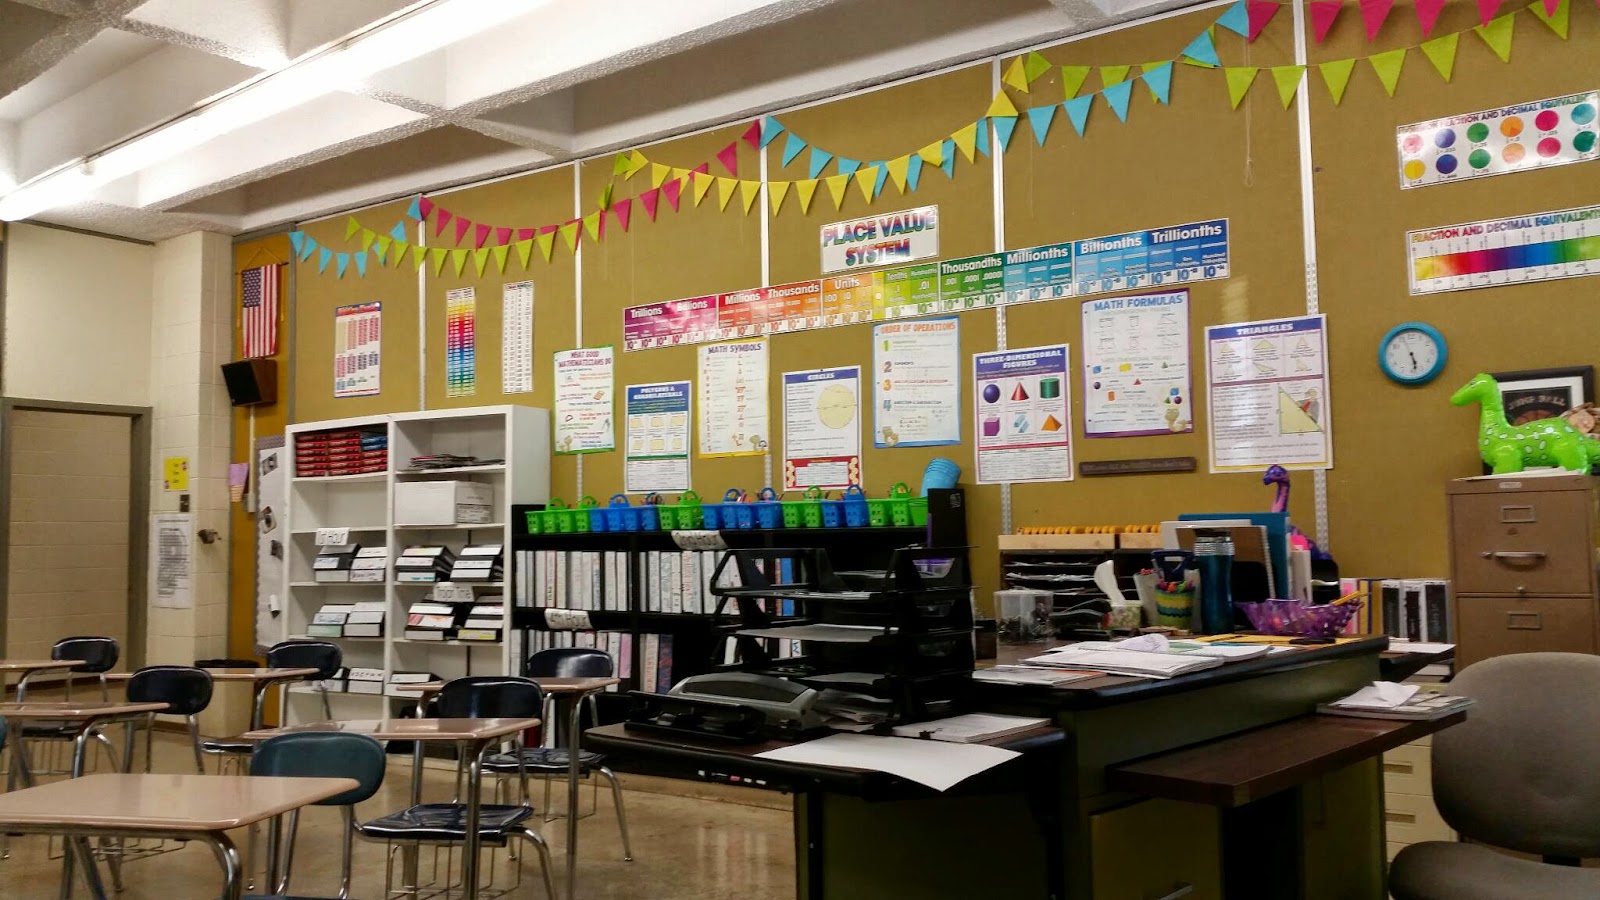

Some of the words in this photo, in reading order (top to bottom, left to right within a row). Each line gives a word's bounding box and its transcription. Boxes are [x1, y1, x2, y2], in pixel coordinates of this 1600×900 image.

[1481, 111, 1499, 121] AND
[1500, 105, 1538, 117] DECIMAL
[823, 219, 878, 248] PLACE
[880, 210, 937, 238] VALUE
[1413, 230, 1460, 244] FRACTION
[1463, 226, 1484, 237] AND
[1487, 219, 1533, 234] DECIMAL
[1536, 208, 1600, 226] EQUIVALENT
[1081, 235, 1143, 255] Billionths
[1152, 224, 1223, 244] Trillionths
[846, 238, 911, 267] SYSTEM
[942, 256, 1003, 274] Thousandths
[1007, 246, 1068, 265] Millionths
[834, 277, 860, 290] Units
[725, 292, 761, 306] Millions
[768, 283, 820, 299] Thousands
[630, 307, 664, 319] Trillions
[677, 300, 709, 313] Billions
[1094, 300, 1123, 312] MATH
[1128, 294, 1184, 309] FORMULAS
[903, 322, 912, 332] OF
[914, 321, 956, 333] OPERATIONS
[1236, 322, 1294, 336] TRIANGLES
[708, 345, 728, 355] MATH
[730, 343, 763, 354] SYMBOLS
[979, 350, 1063, 365] THREE-DIMENSIONAL
[1003, 359, 1038, 370] FIGURES
[884, 360, 893, 373] 2
[883, 378, 892, 392] 3
